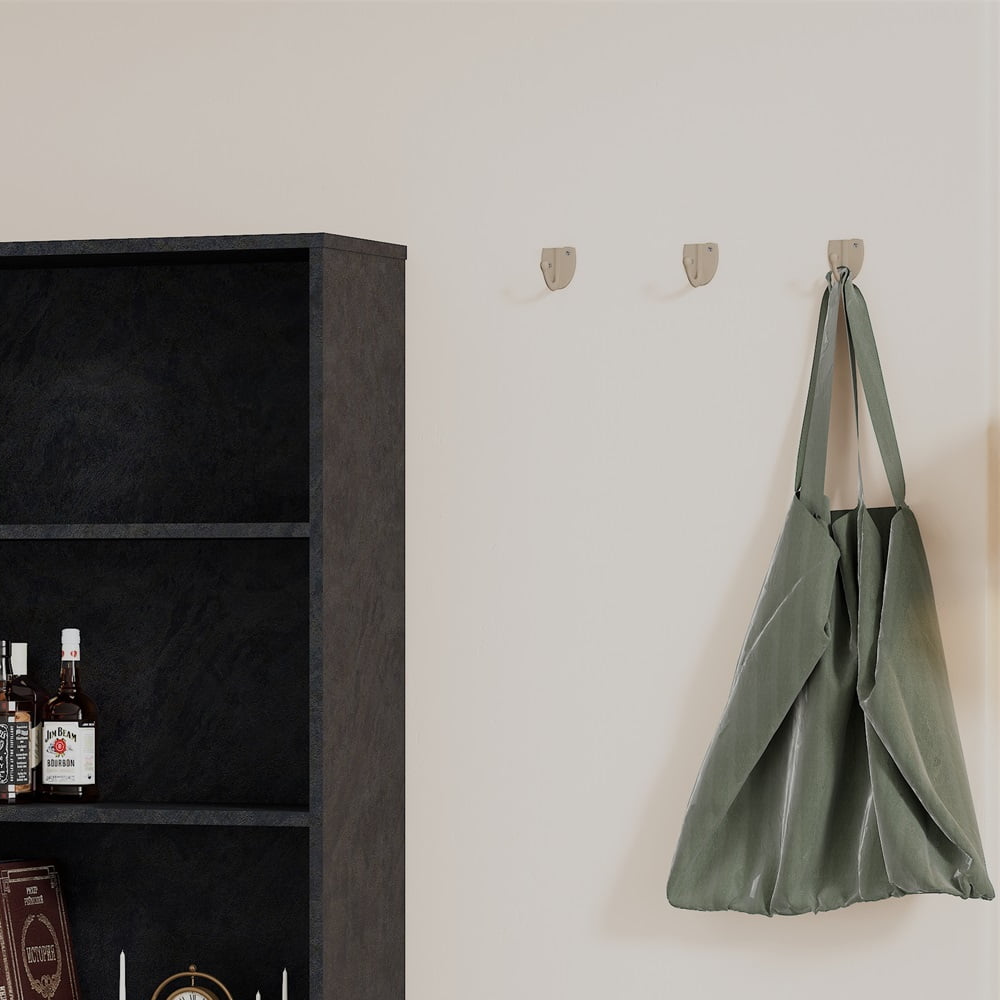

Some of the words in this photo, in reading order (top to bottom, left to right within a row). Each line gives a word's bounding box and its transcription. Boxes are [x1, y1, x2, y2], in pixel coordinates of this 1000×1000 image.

[45, 729, 57, 743] JIM
[57, 726, 77, 743] BEAM
[47, 758, 75, 767] BOURBON
[26, 944, 56, 964] ИСТОРИЯ
